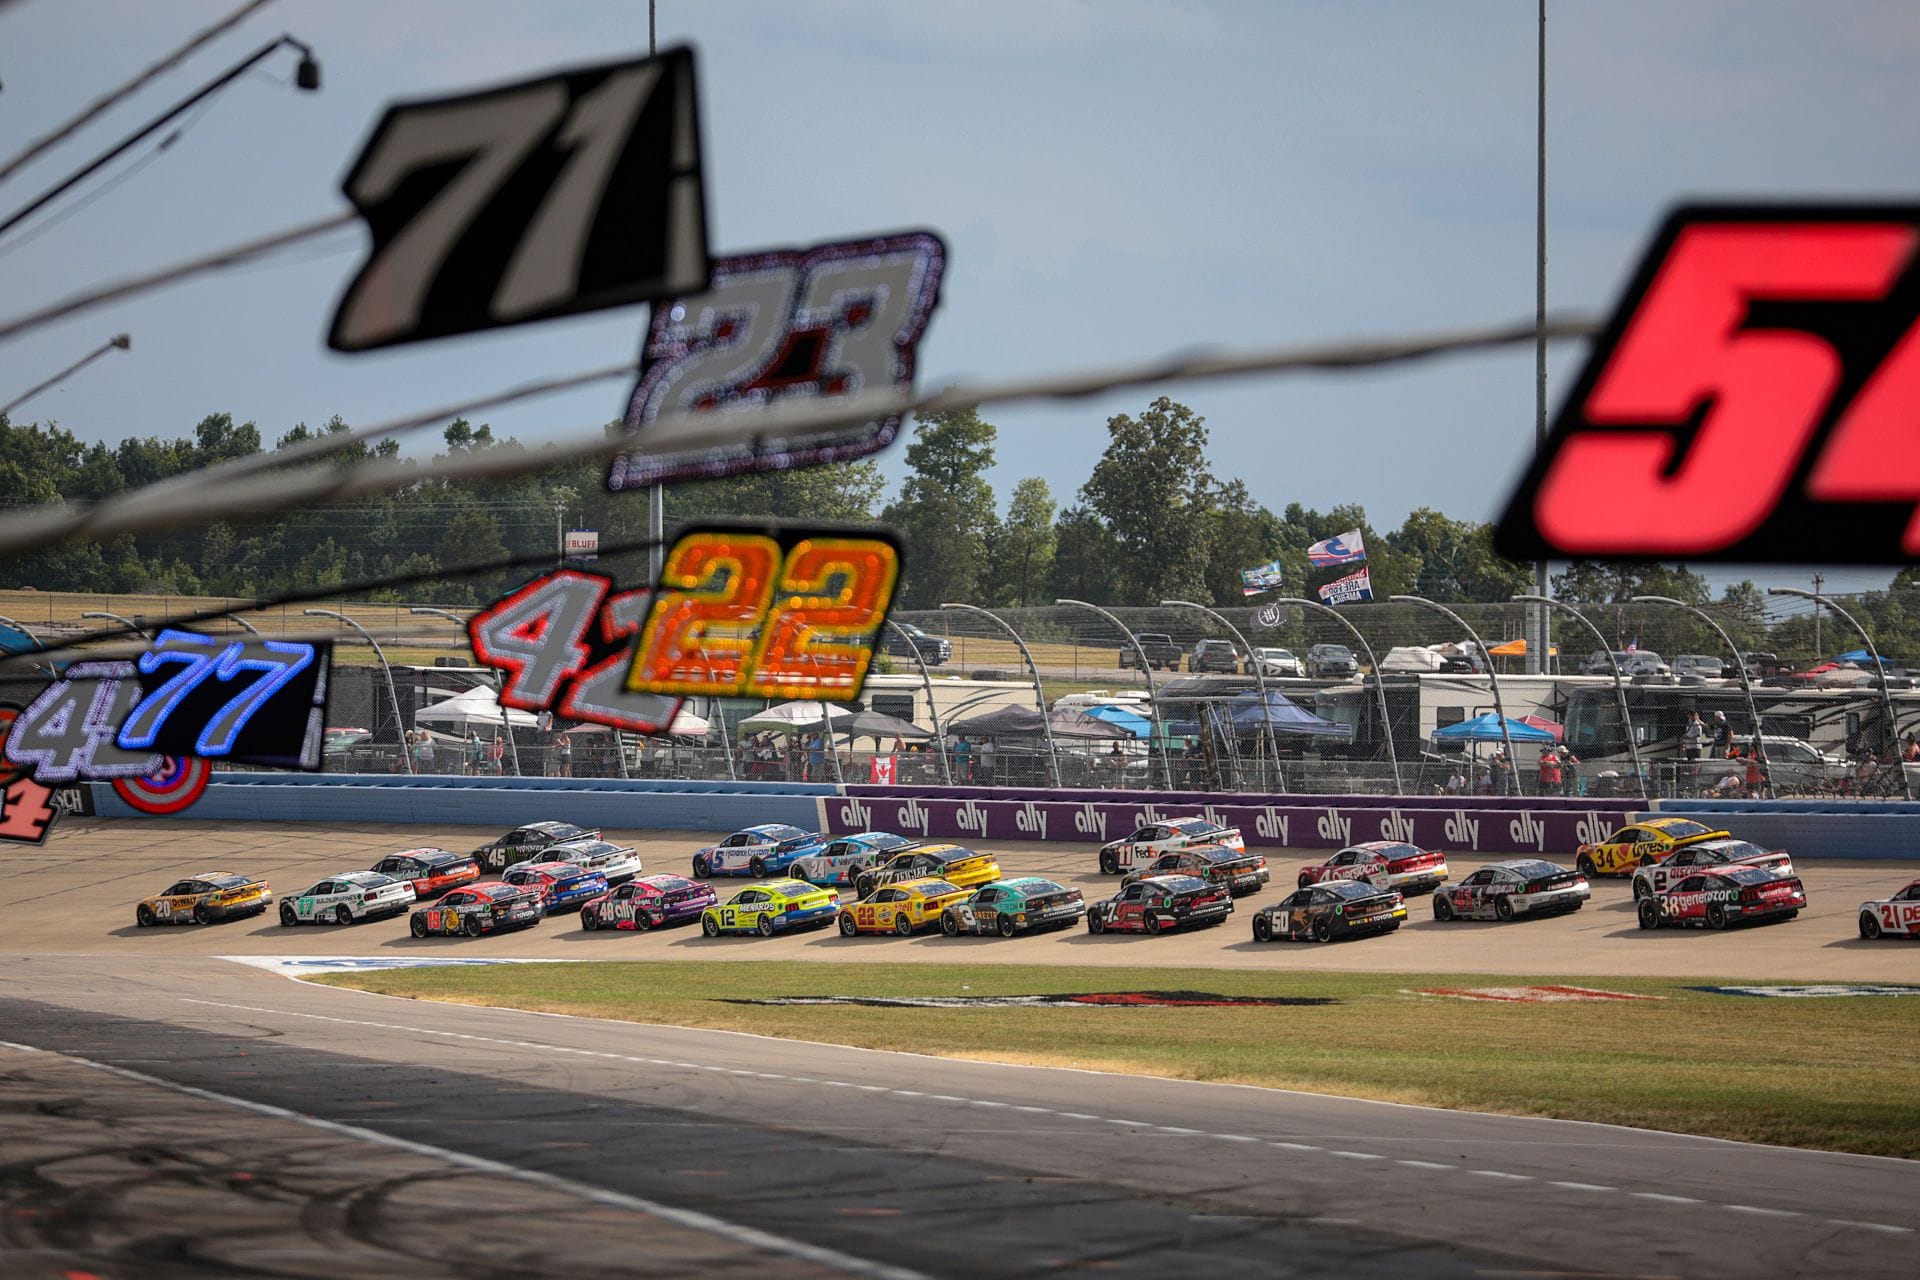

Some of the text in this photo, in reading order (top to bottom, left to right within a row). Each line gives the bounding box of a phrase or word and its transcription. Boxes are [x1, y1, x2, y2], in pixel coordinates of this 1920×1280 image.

[338, 58, 668, 348] 71
[610, 232, 946, 488] 23
[571, 540, 597, 548] BLUFF
[629, 533, 899, 699] 22
[117, 629, 314, 756] 77
[840, 800, 871, 832] ally
[898, 800, 929, 836] ally
[956, 801, 987, 837] ally
[1015, 803, 1046, 839] ally
[1074, 804, 1106, 841] ally
[1256, 808, 1289, 846] ally
[1380, 810, 1414, 845] ally
[1317, 809, 1351, 847] ally
[1444, 811, 1478, 850] ally
[1509, 811, 1544, 851] ally
[489, 848, 506, 866] 45
[713, 850, 725, 868] 5
[1118, 845, 1134, 865] 11
[1595, 848, 1615, 868] 34
[810, 861, 826, 878] 24
[876, 871, 895, 887] 77
[1654, 871, 1667, 892] 2
[156, 899, 171, 918] 20
[298, 897, 315, 917] 17
[600, 899, 636, 922] 48 ally
[1455, 888, 1473, 911] 41
[1660, 894, 1681, 918] 38
[427, 909, 440, 929] 19
[720, 902, 775, 927] 12 MENARDS
[857, 906, 876, 926] 22
[958, 904, 977, 926] 3
[1107, 902, 1117, 923] 7
[1271, 911, 1290, 932] 50
[1372, 913, 1393, 922] TOYOTA
[1881, 904, 1902, 929] 21
